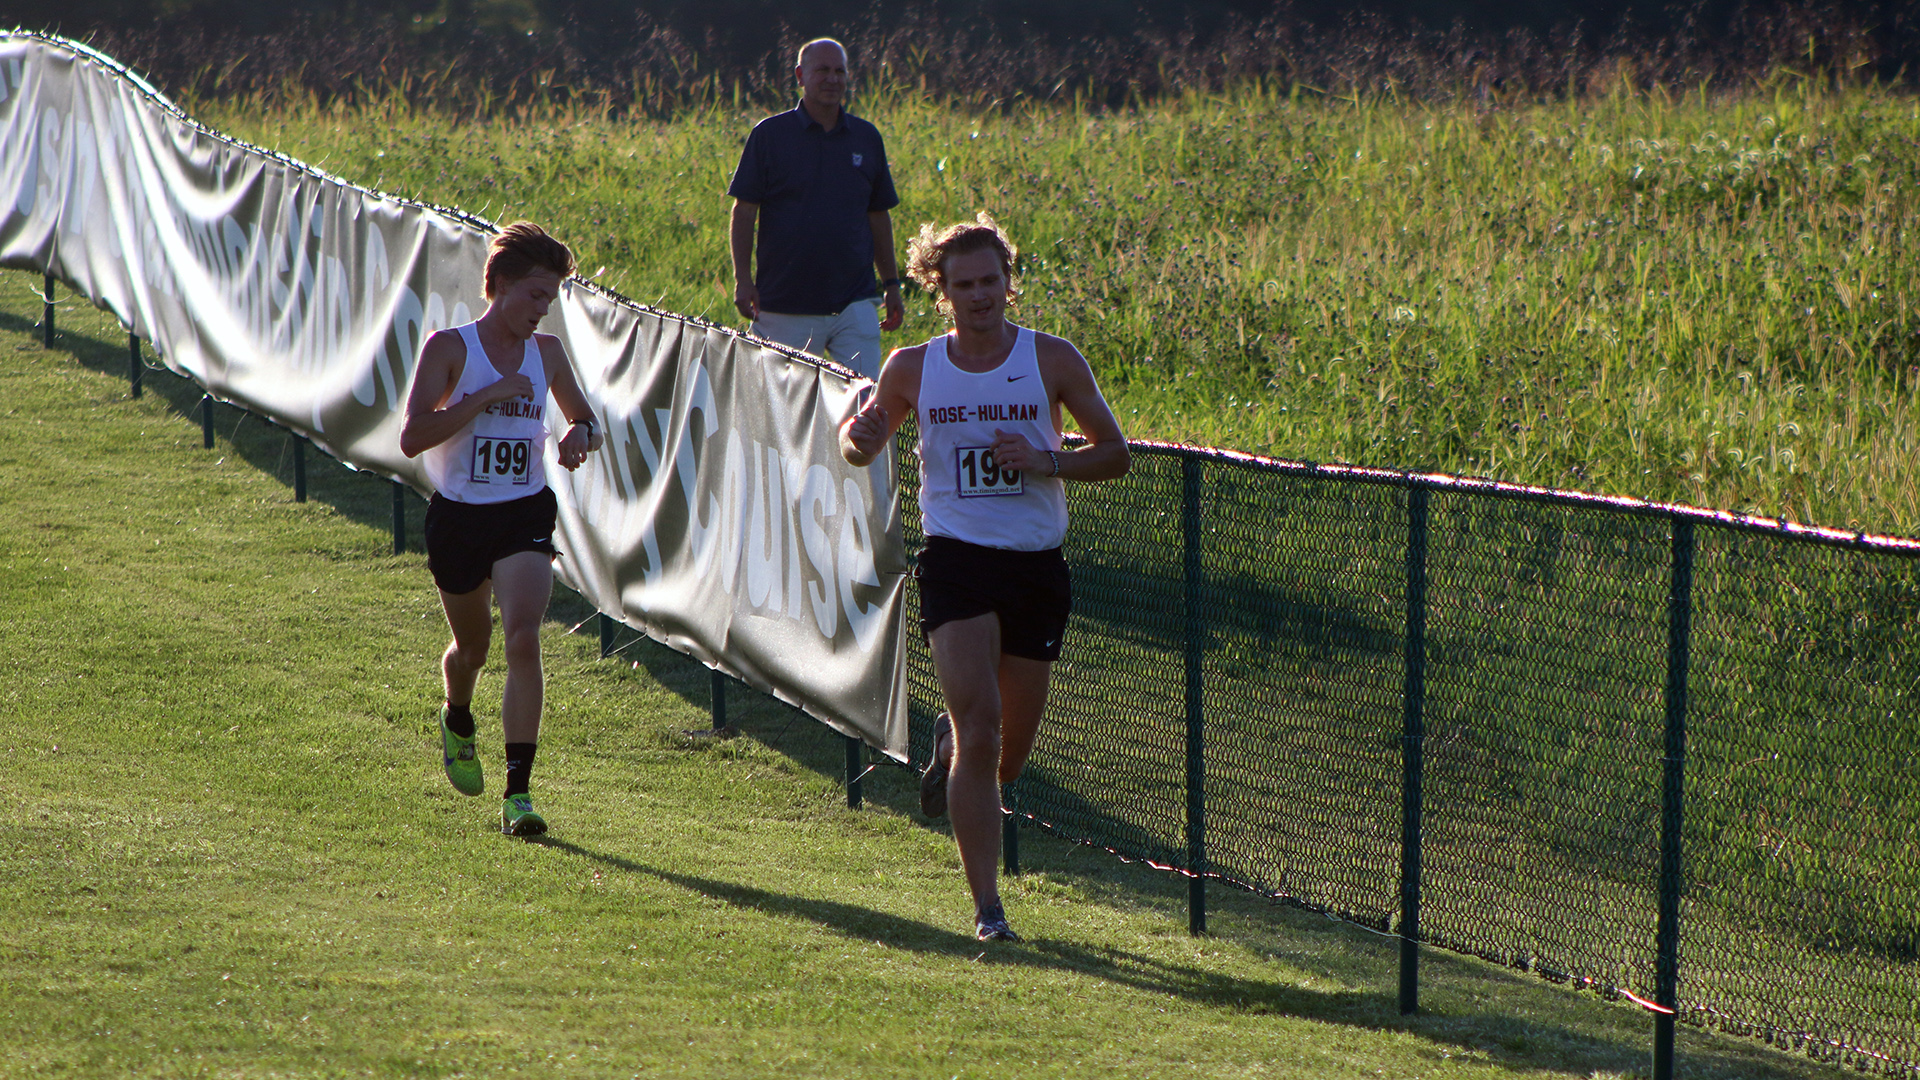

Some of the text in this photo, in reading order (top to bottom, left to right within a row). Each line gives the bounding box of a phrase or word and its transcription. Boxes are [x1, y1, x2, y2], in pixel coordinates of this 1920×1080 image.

[929, 404, 1038, 424] ROSE-HULMAN
[478, 440, 527, 475] 199
[674, 358, 883, 653] Course
